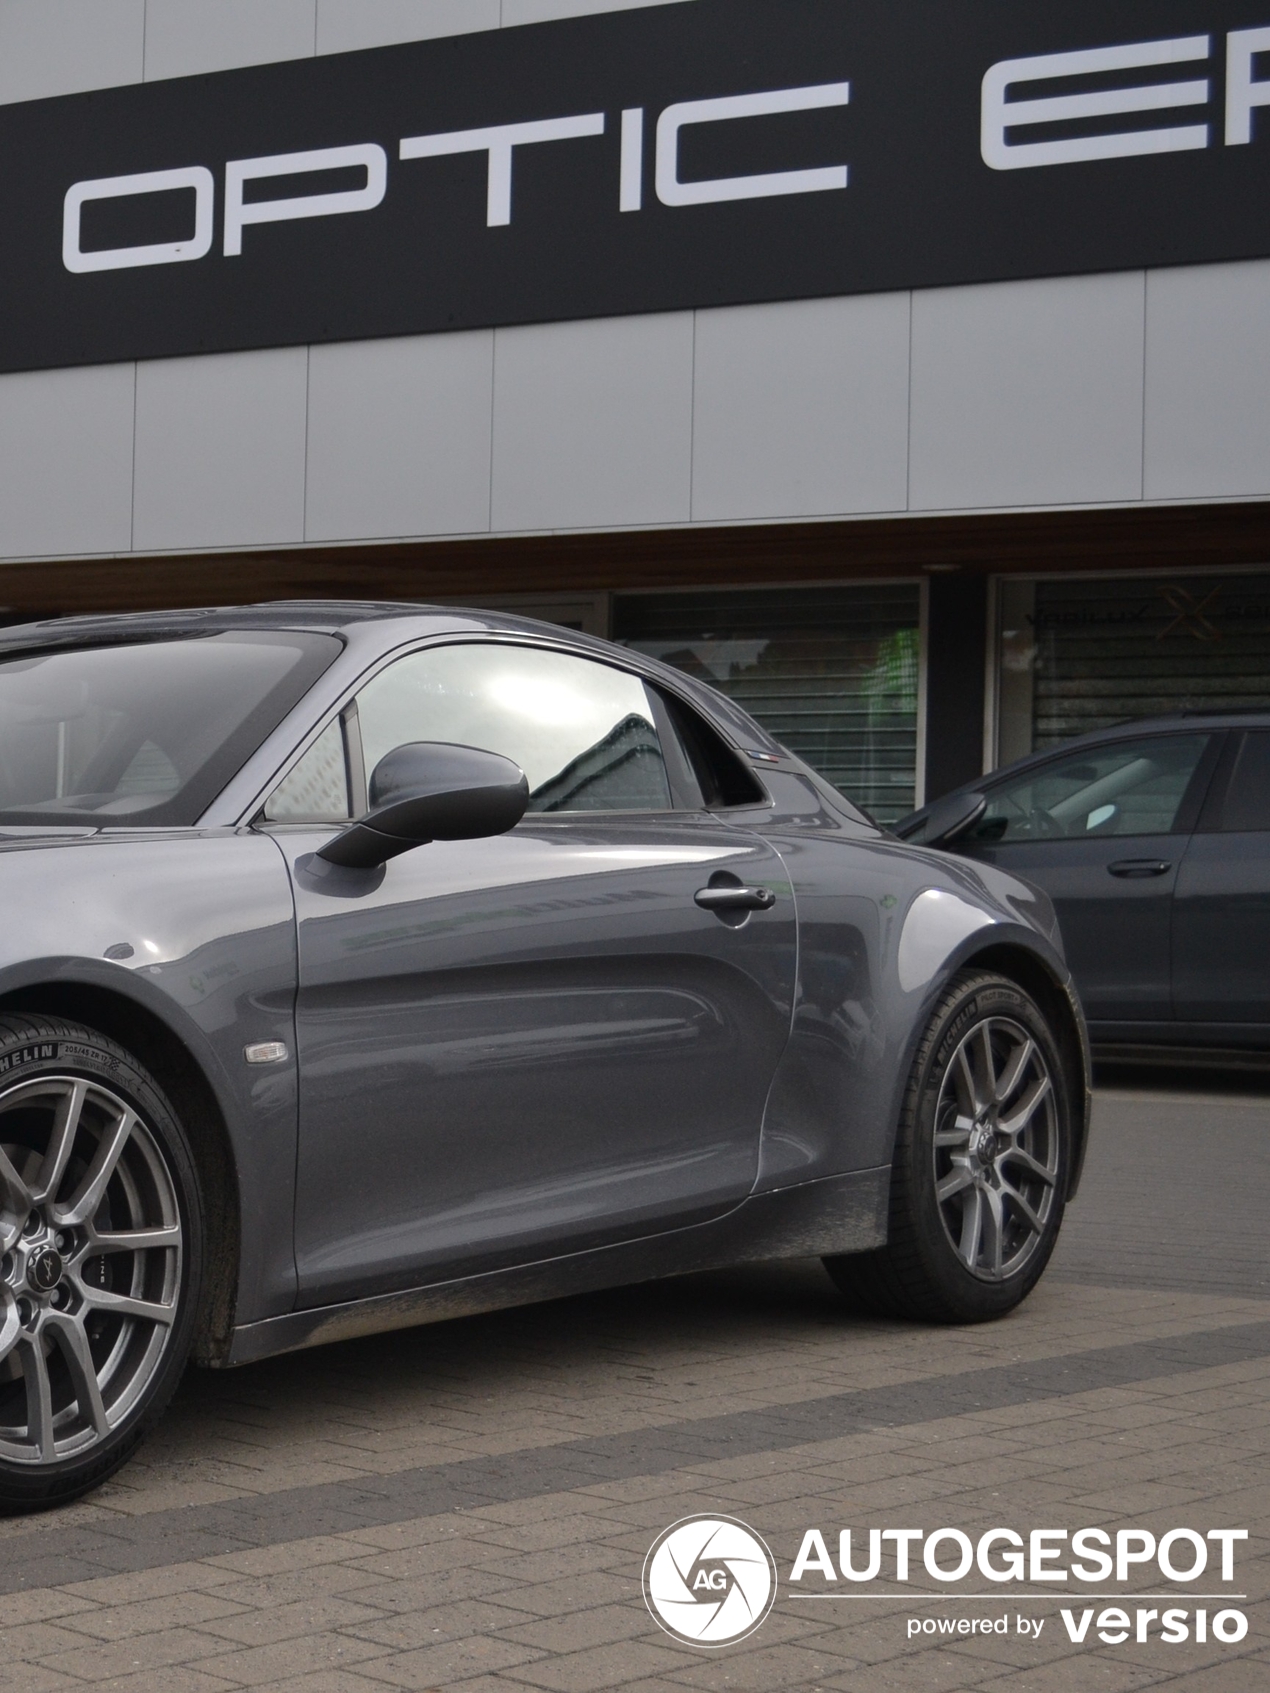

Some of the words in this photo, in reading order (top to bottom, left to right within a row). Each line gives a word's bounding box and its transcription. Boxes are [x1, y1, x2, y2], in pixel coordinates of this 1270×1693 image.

[62, 81, 850, 274] OPTIC
[980, 26, 1270, 171] E
[65, 1045, 89, 1056] 205/45
[90, 1050, 100, 1059] ZR
[101, 1055, 107, 1063] 17
[937, 999, 976, 1065] MICHELIN
